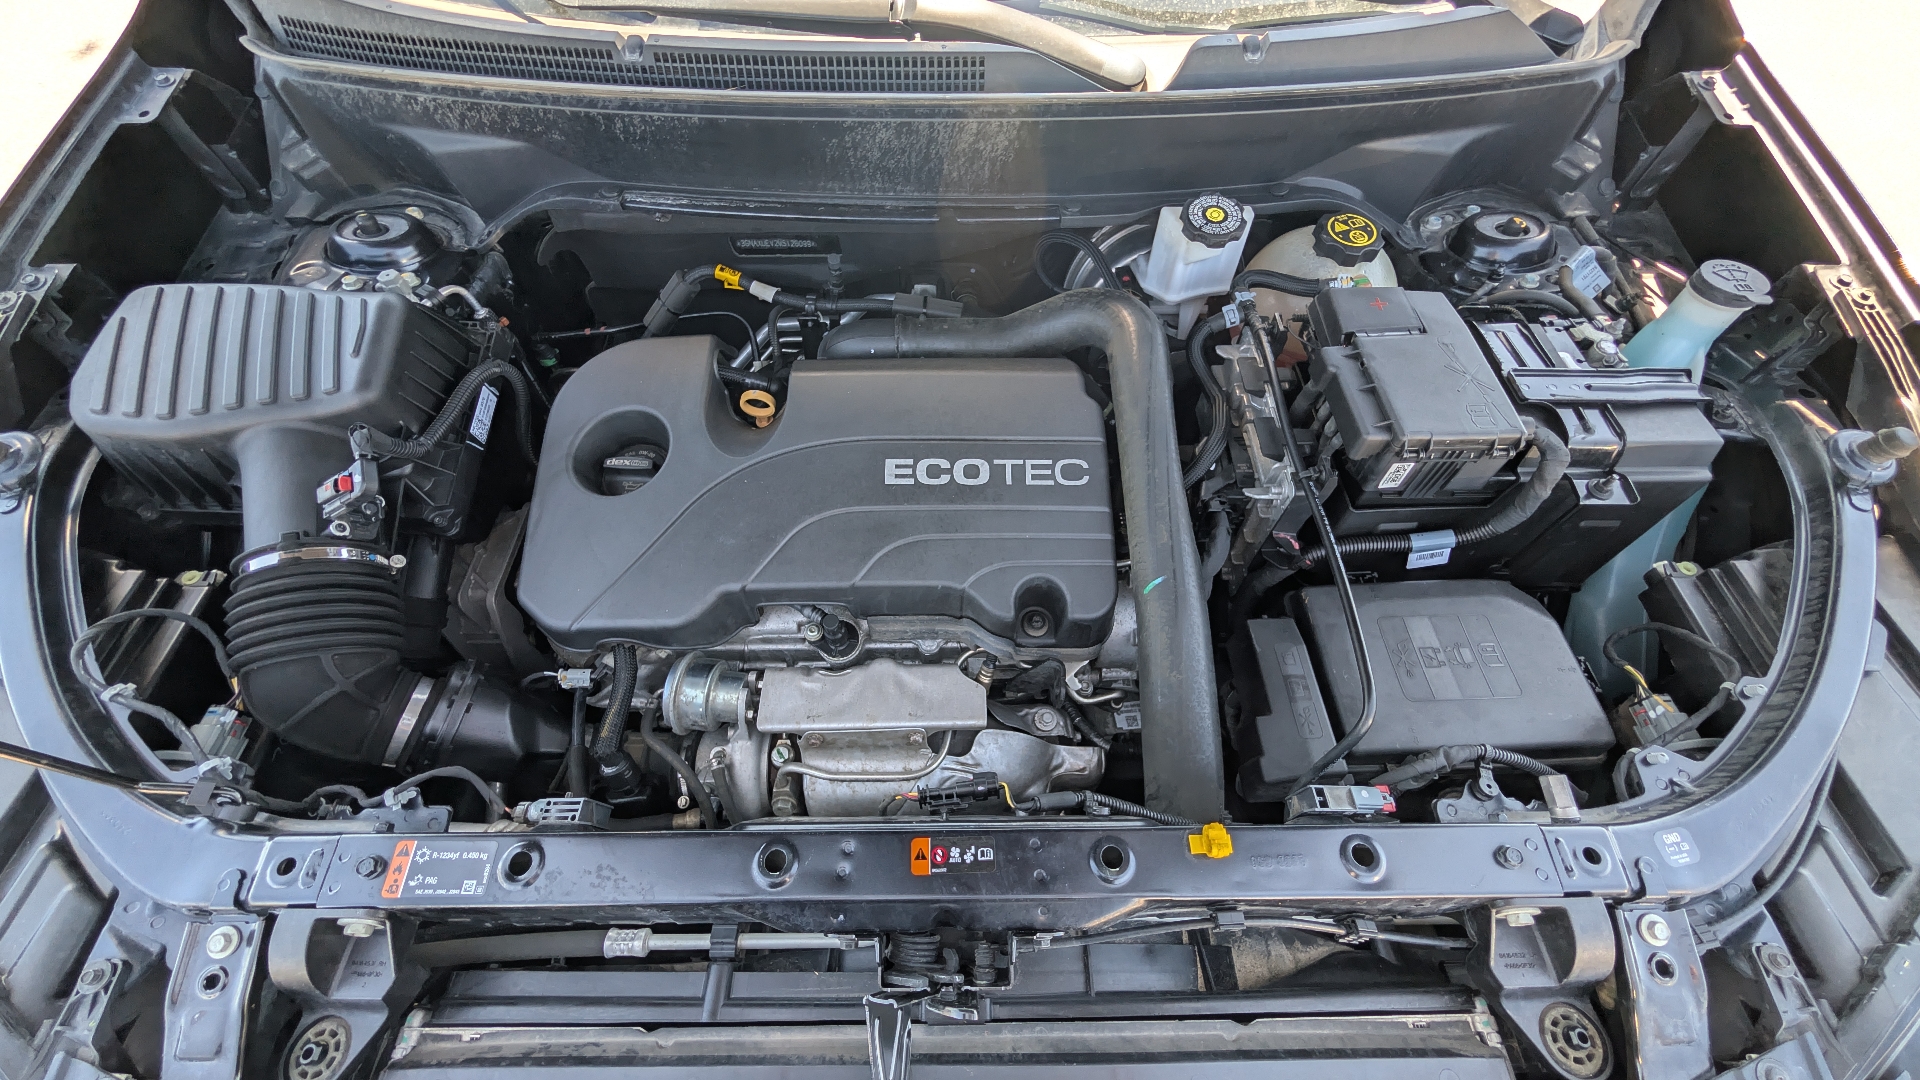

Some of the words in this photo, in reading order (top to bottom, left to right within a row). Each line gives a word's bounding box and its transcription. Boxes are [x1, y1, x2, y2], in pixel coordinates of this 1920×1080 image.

[884, 458, 1090, 486] ECOTEC
[1662, 832, 1681, 845] GND
[432, 851, 460, 860] R-1234yf
[479, 851, 489, 861] kg
[424, 876, 438, 885] PAG
